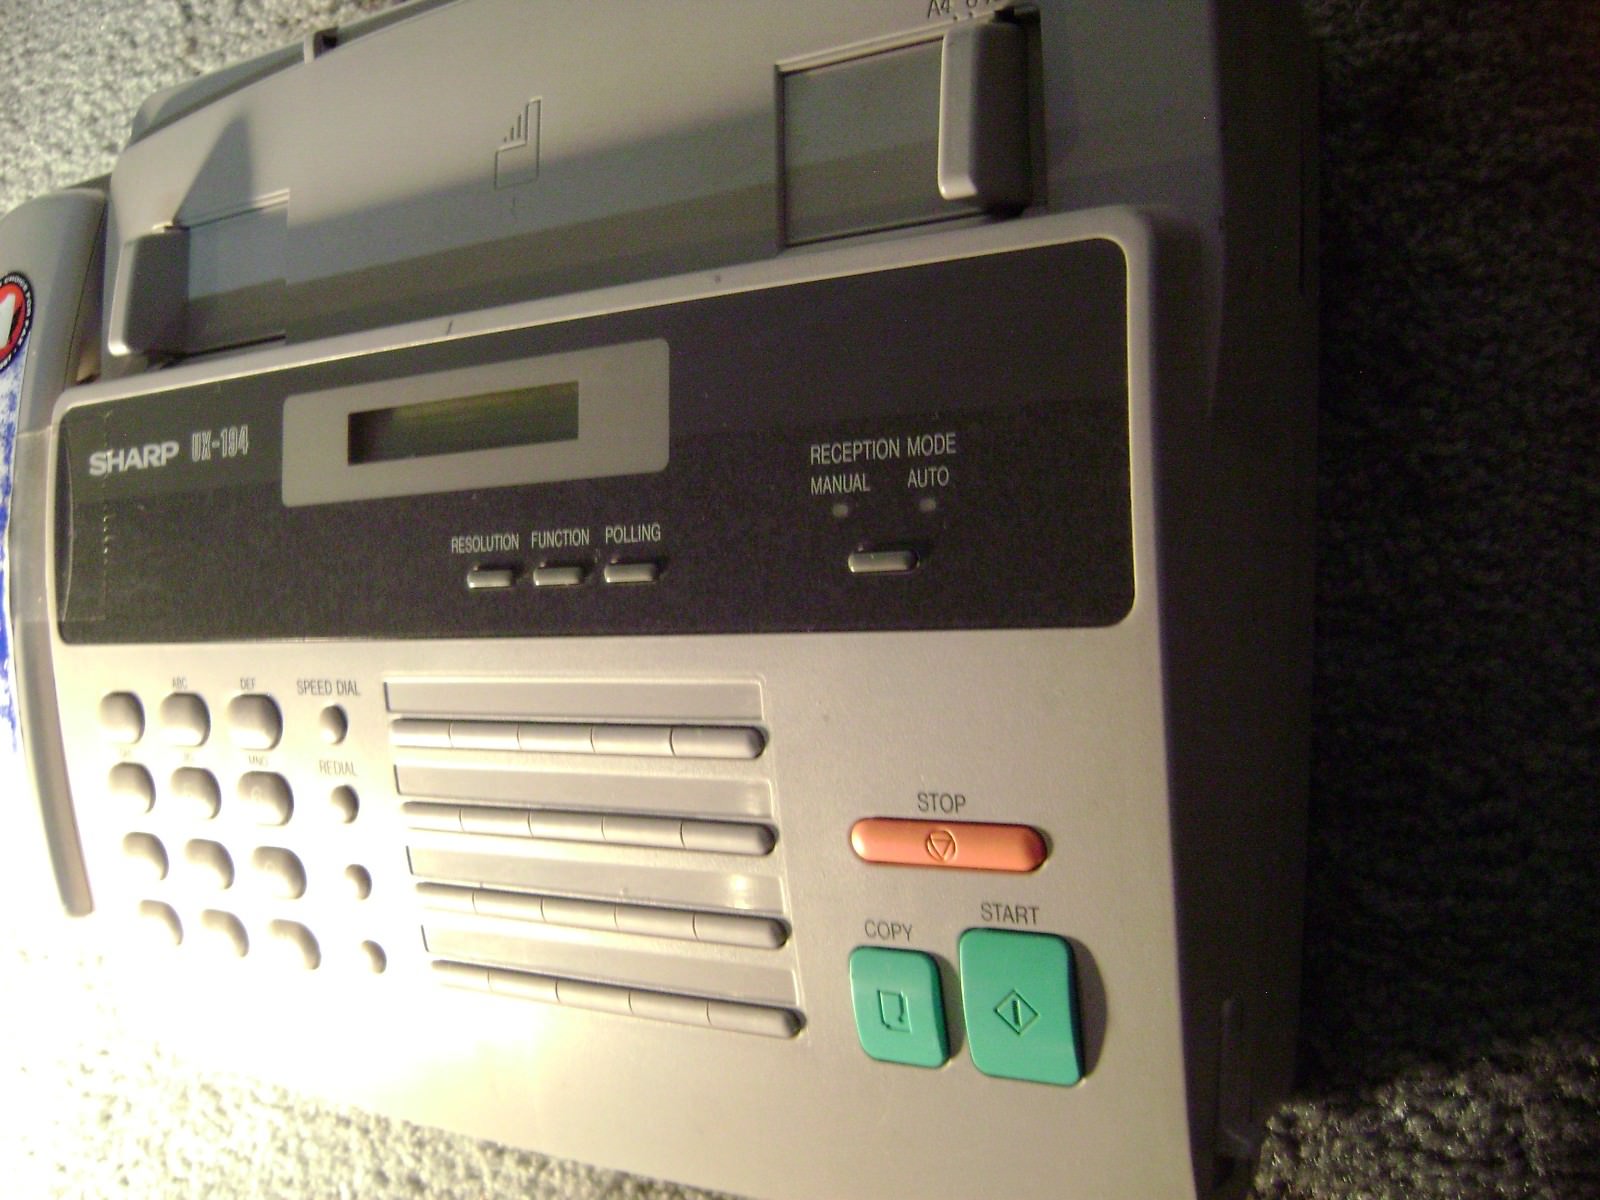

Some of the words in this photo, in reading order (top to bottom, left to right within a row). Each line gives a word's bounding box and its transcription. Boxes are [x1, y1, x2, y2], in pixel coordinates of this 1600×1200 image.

[89, 441, 180, 476] SHARP
[810, 437, 900, 465] RECEPTION
[907, 432, 957, 457] MODE
[811, 472, 871, 495] MANUAL
[908, 466, 950, 489] AUTO
[451, 532, 519, 554] RESOLUTION
[531, 528, 590, 549] FUNCTION
[605, 522, 662, 544] POLLING
[296, 679, 333, 697] SPEED
[336, 679, 361, 697] DIAL
[319, 759, 358, 776] REDIAL
[917, 792, 966, 814] STOP
[981, 902, 1040, 925] START
[864, 918, 913, 942] COPY
